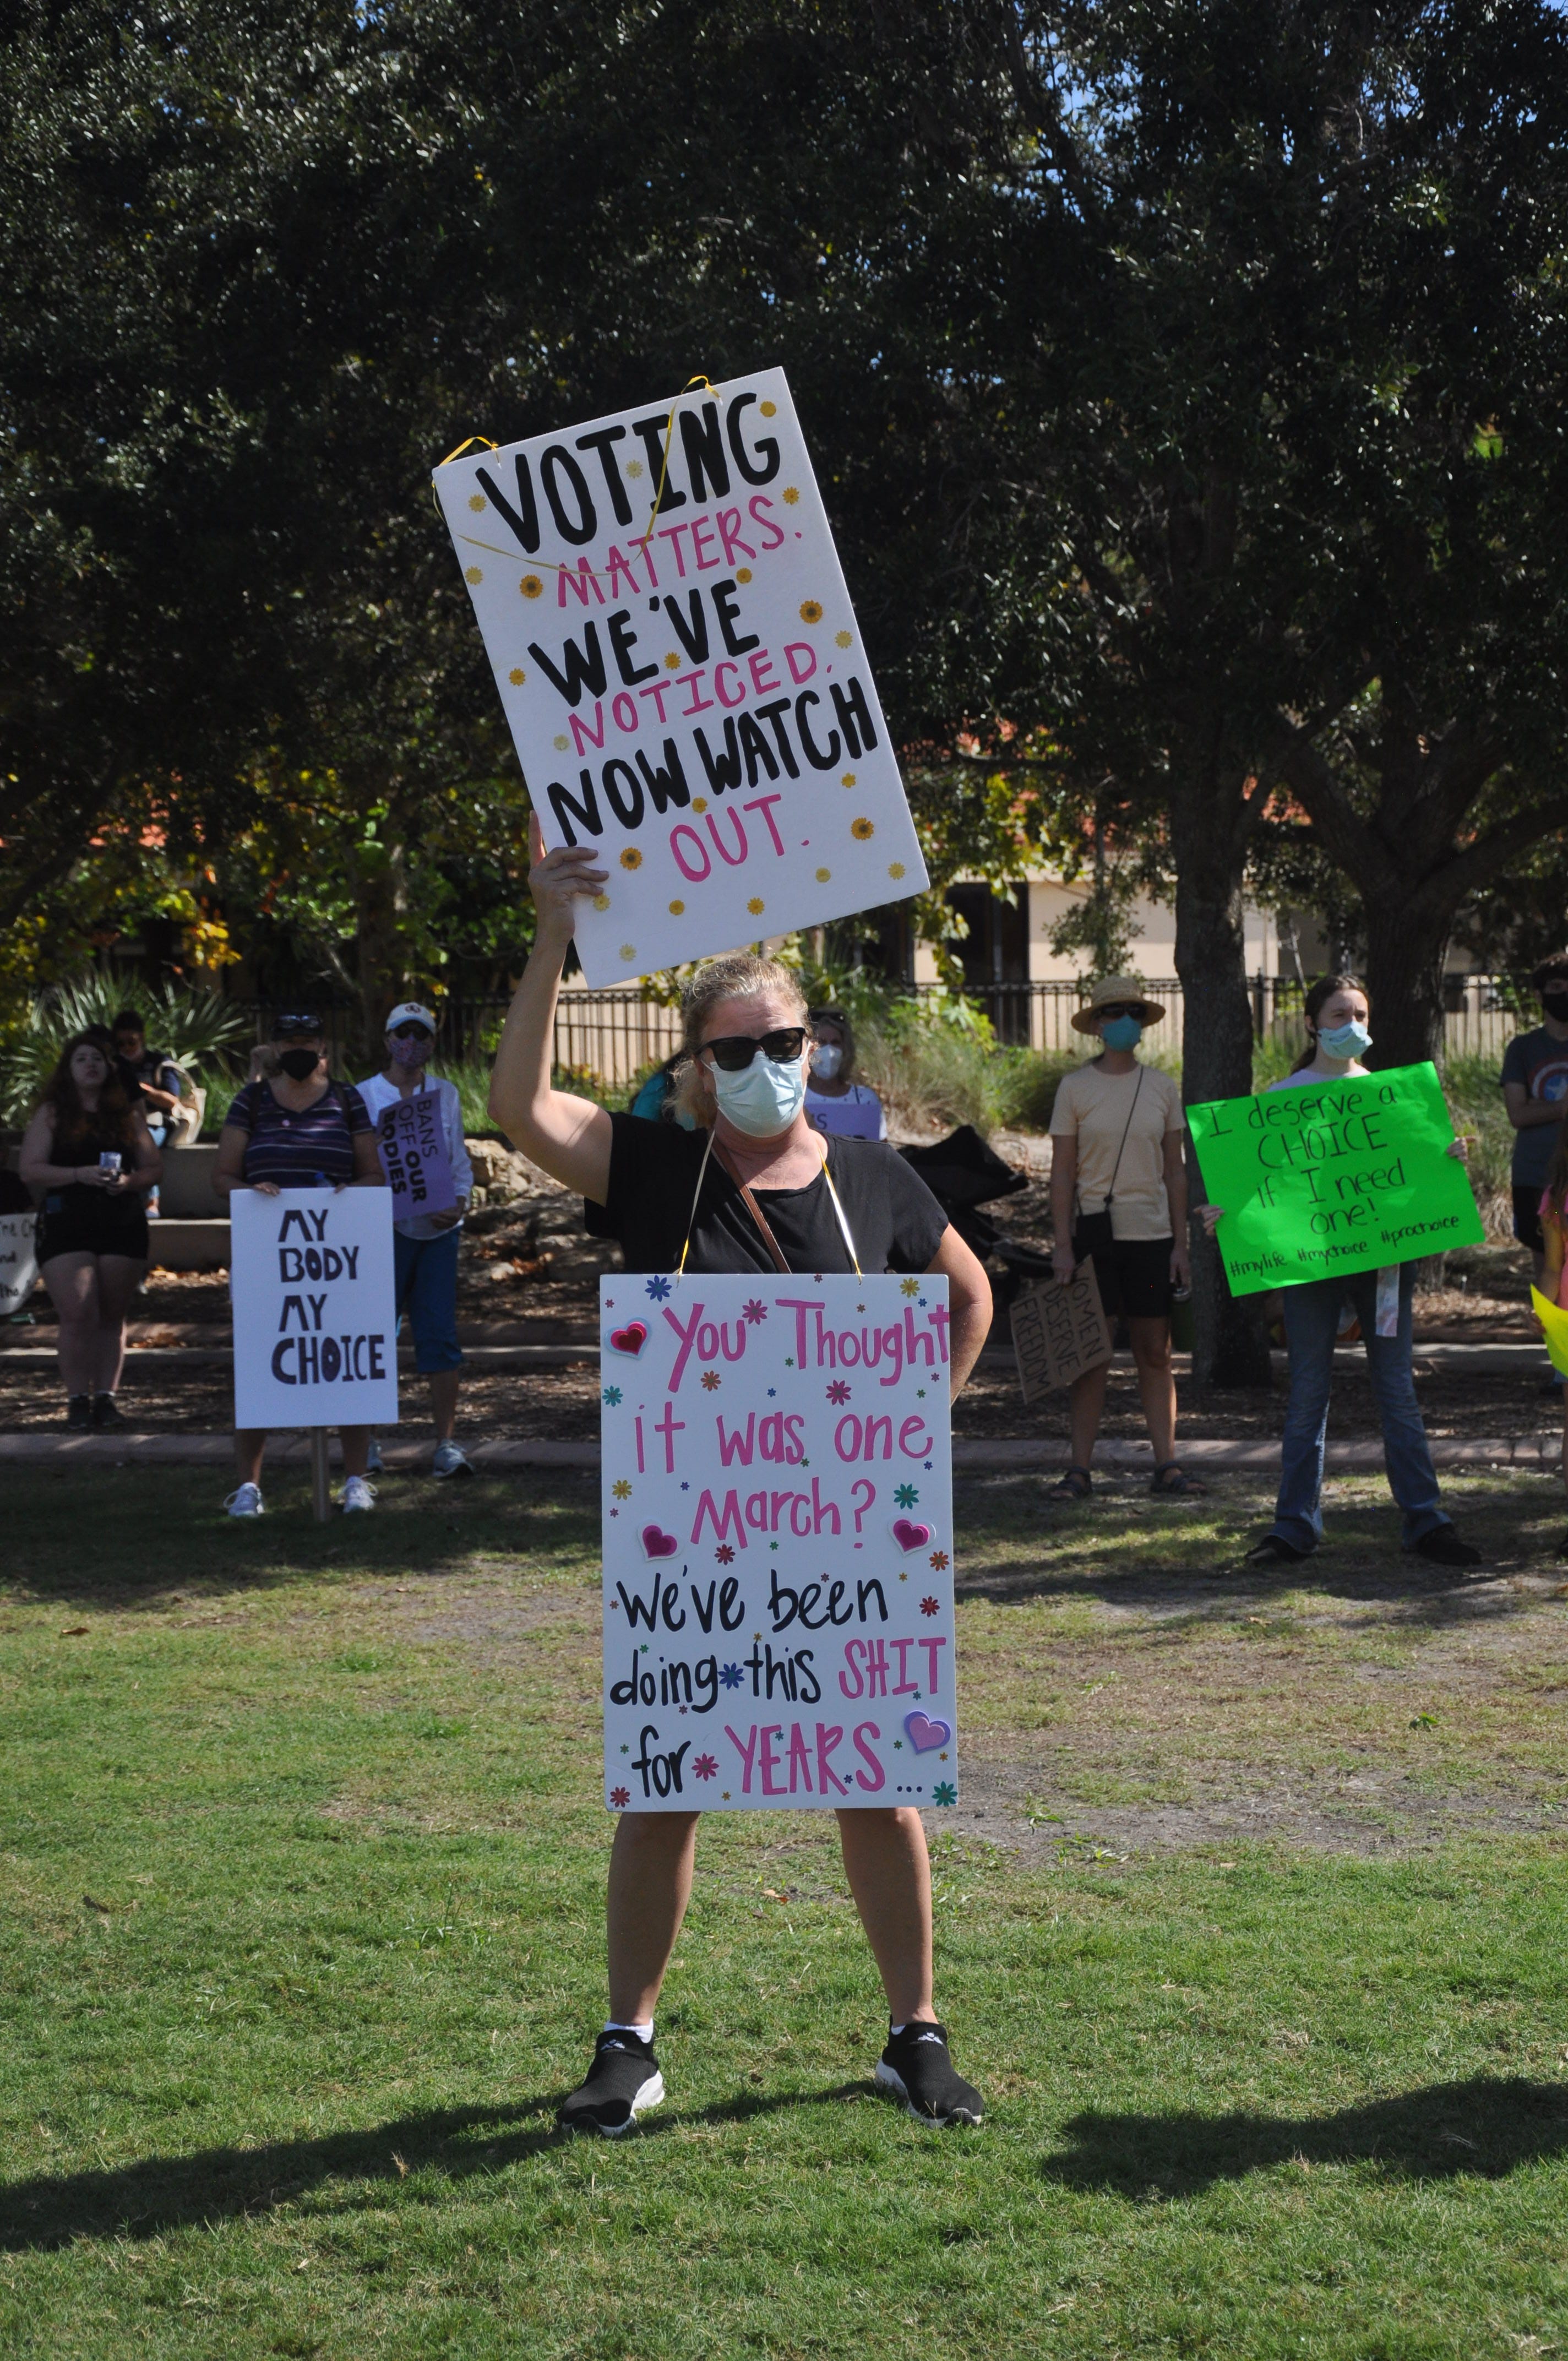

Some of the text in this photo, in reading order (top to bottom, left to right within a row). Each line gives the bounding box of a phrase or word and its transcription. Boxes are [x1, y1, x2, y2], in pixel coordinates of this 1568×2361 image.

[475, 392, 780, 554] VOTING
[557, 494, 803, 608] MATTERS.
[527, 579, 760, 708] WE'VE
[547, 677, 878, 847] NOW WATCH
[669, 793, 810, 883] OUT.
[417, 1099, 438, 1157] BANS
[1201, 1084, 1397, 1138] I deserve a
[1257, 1112, 1387, 1169] CHOICE
[382, 1110, 407, 1195] BODIES
[399, 1105, 427, 1203] OFF OUR
[1301, 1167, 1326, 1204] I
[1335, 1157, 1406, 1200] need
[278, 1209, 329, 1242] MY
[1230, 1215, 1460, 1277] #mylife #mychoice #prochoice
[1310, 1197, 1379, 1235] one!
[279, 1246, 360, 1282] BODY
[279, 1293, 328, 1332] MY
[662, 1299, 950, 1393] You Thought
[1011, 1297, 1050, 1397] FREEDOM
[271, 1334, 385, 1385] CHOICE
[635, 1401, 933, 1474] it was one
[690, 1477, 876, 1549] March?
[767, 1569, 889, 1633] been
[609, 1637, 947, 1714] doing this SHIT
[631, 1725, 691, 1798] for
